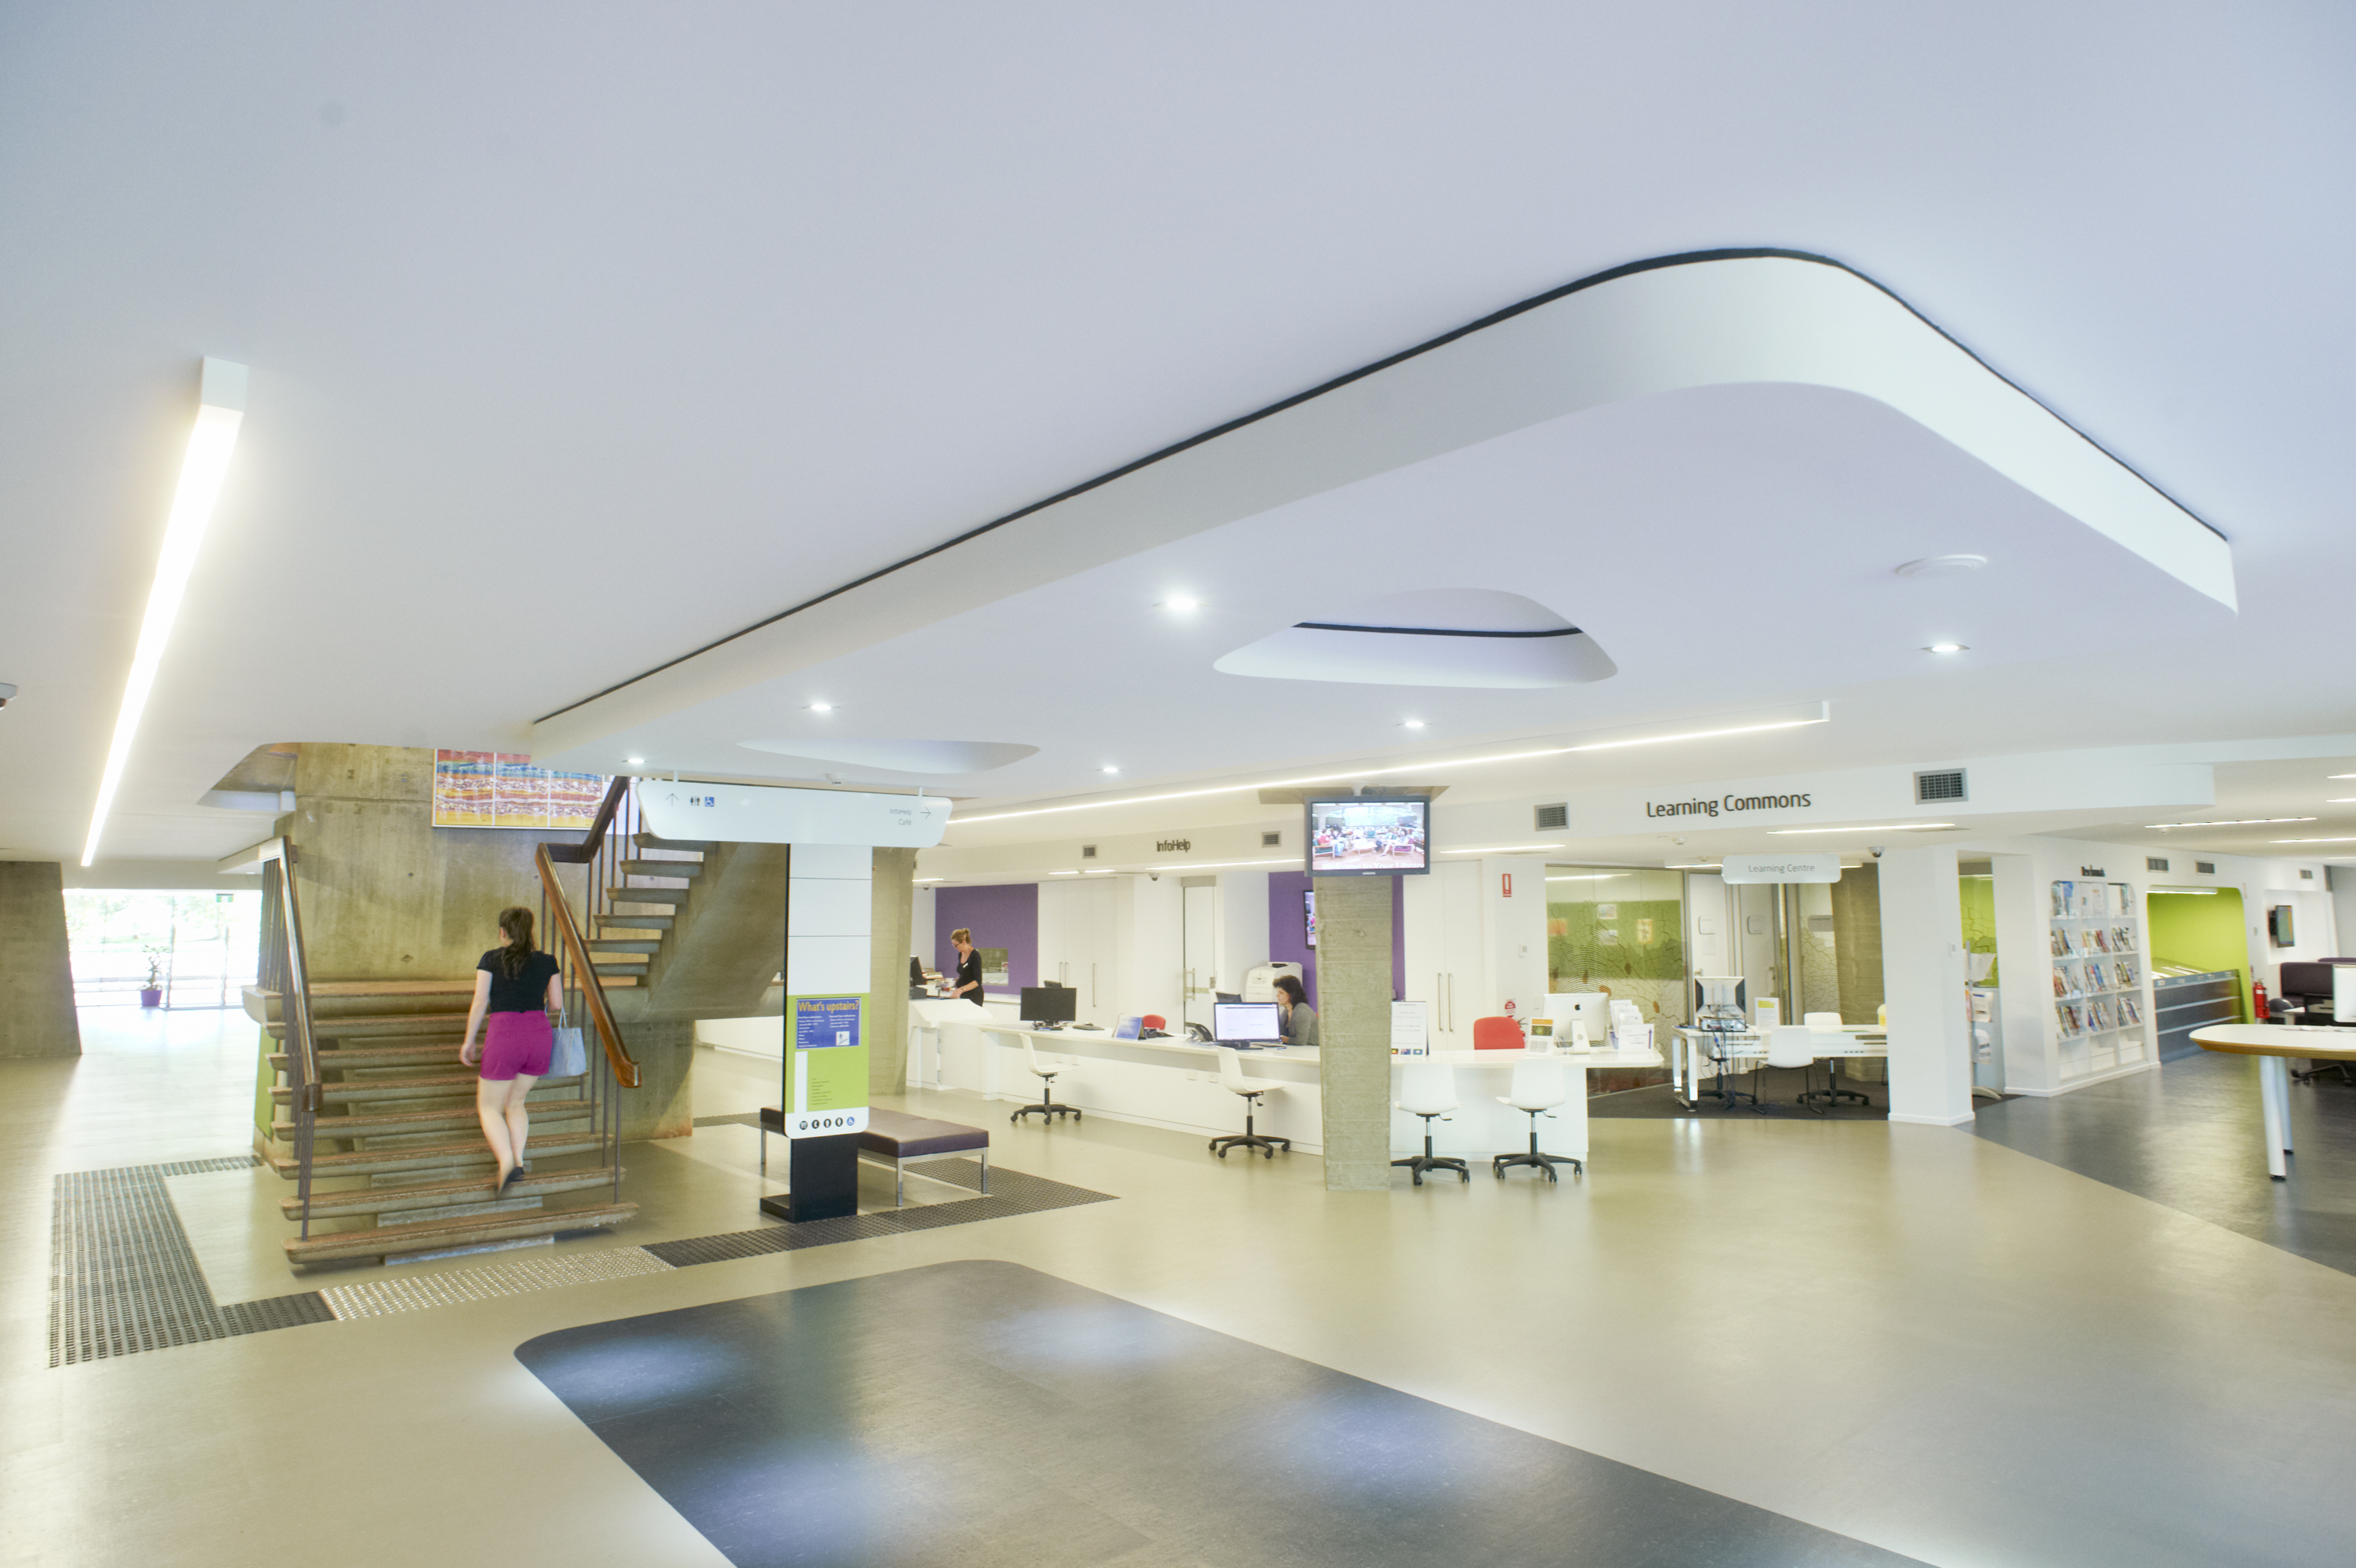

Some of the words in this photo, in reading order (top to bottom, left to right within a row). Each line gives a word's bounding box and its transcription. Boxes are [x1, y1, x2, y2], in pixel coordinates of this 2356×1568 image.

[1646, 798, 1719, 817] Learning
[1724, 793, 1811, 812] Commons
[1157, 839, 1191, 853] InfoHelp
[1748, 864, 1785, 874] Learning
[1787, 864, 1816, 872] Centre
[798, 1001, 825, 1012] What's
[826, 1000, 859, 1014] upstairs?
